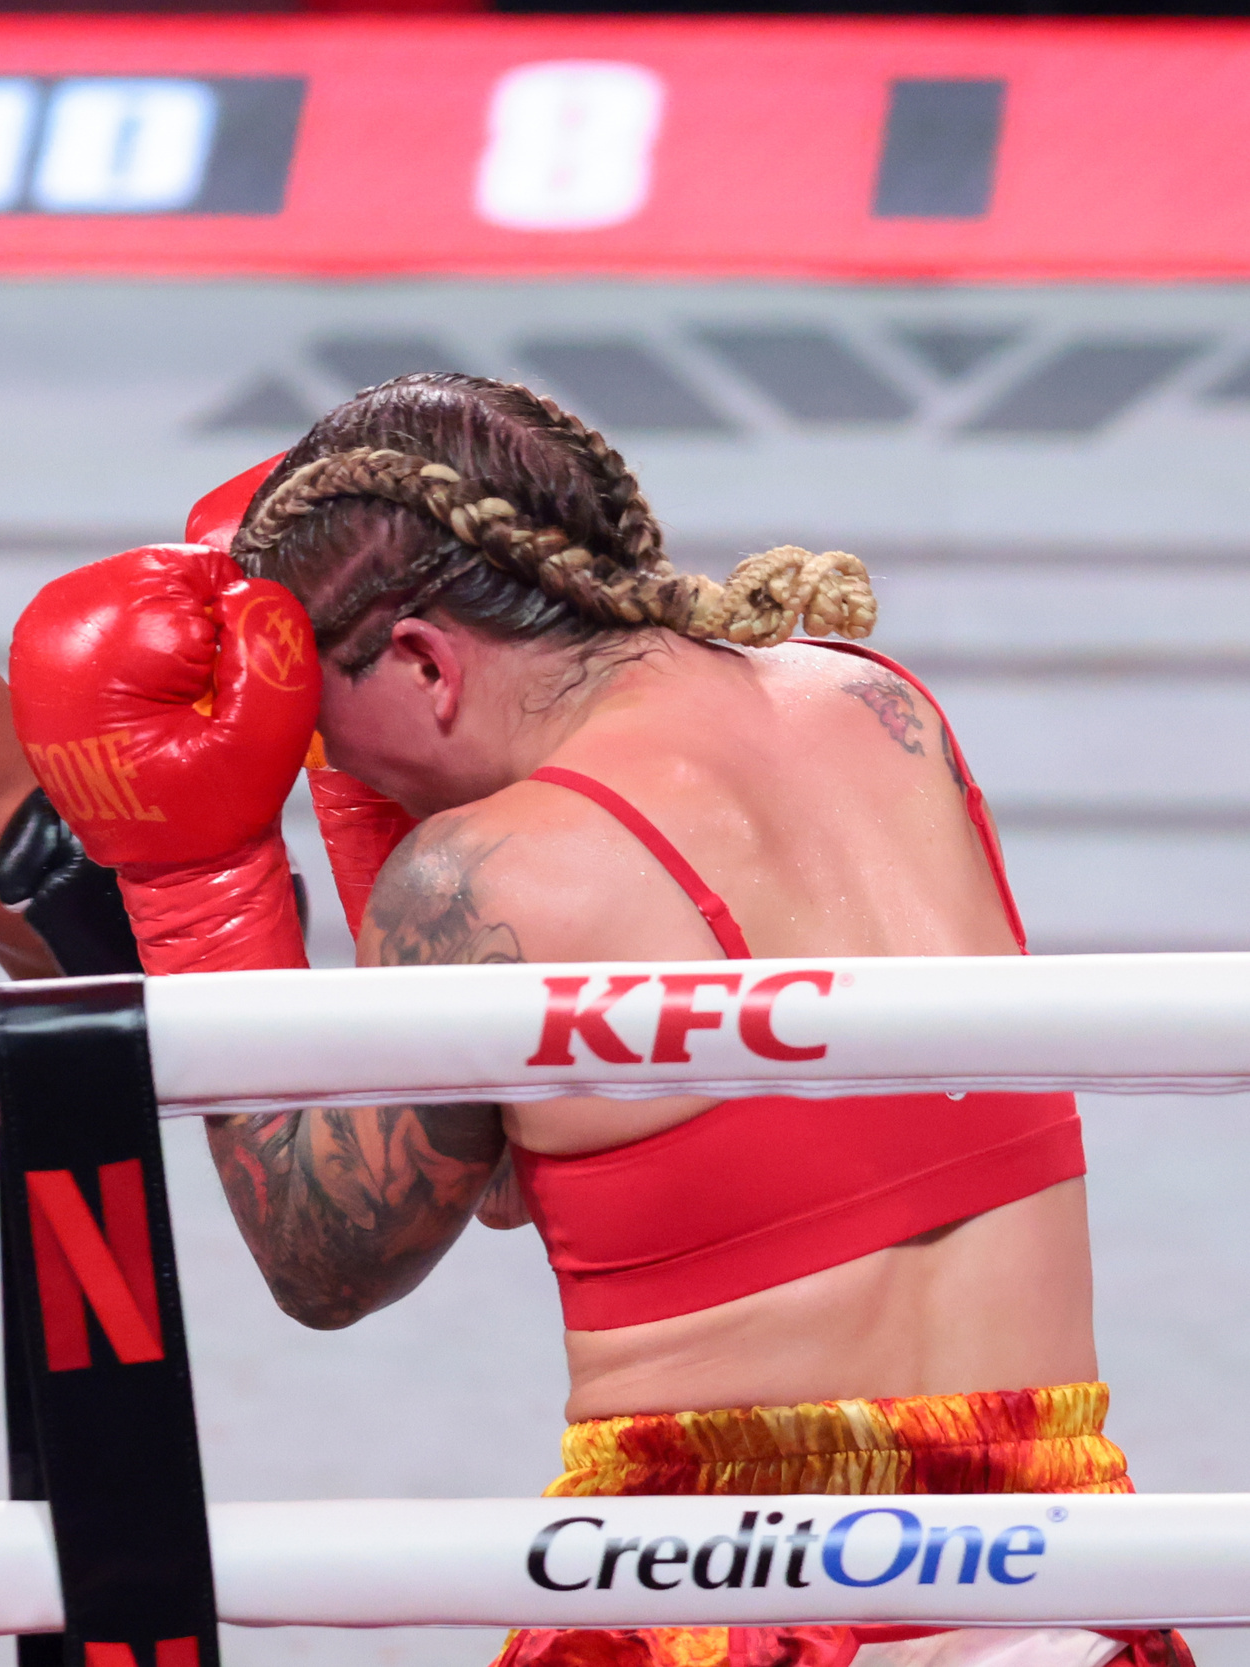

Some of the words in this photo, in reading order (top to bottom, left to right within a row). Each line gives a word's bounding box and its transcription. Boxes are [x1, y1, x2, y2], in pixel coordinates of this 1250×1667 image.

[526, 970, 835, 1067] KFC
[24, 1157, 165, 1372] N
[526, 1507, 1047, 1592] CreditOne
